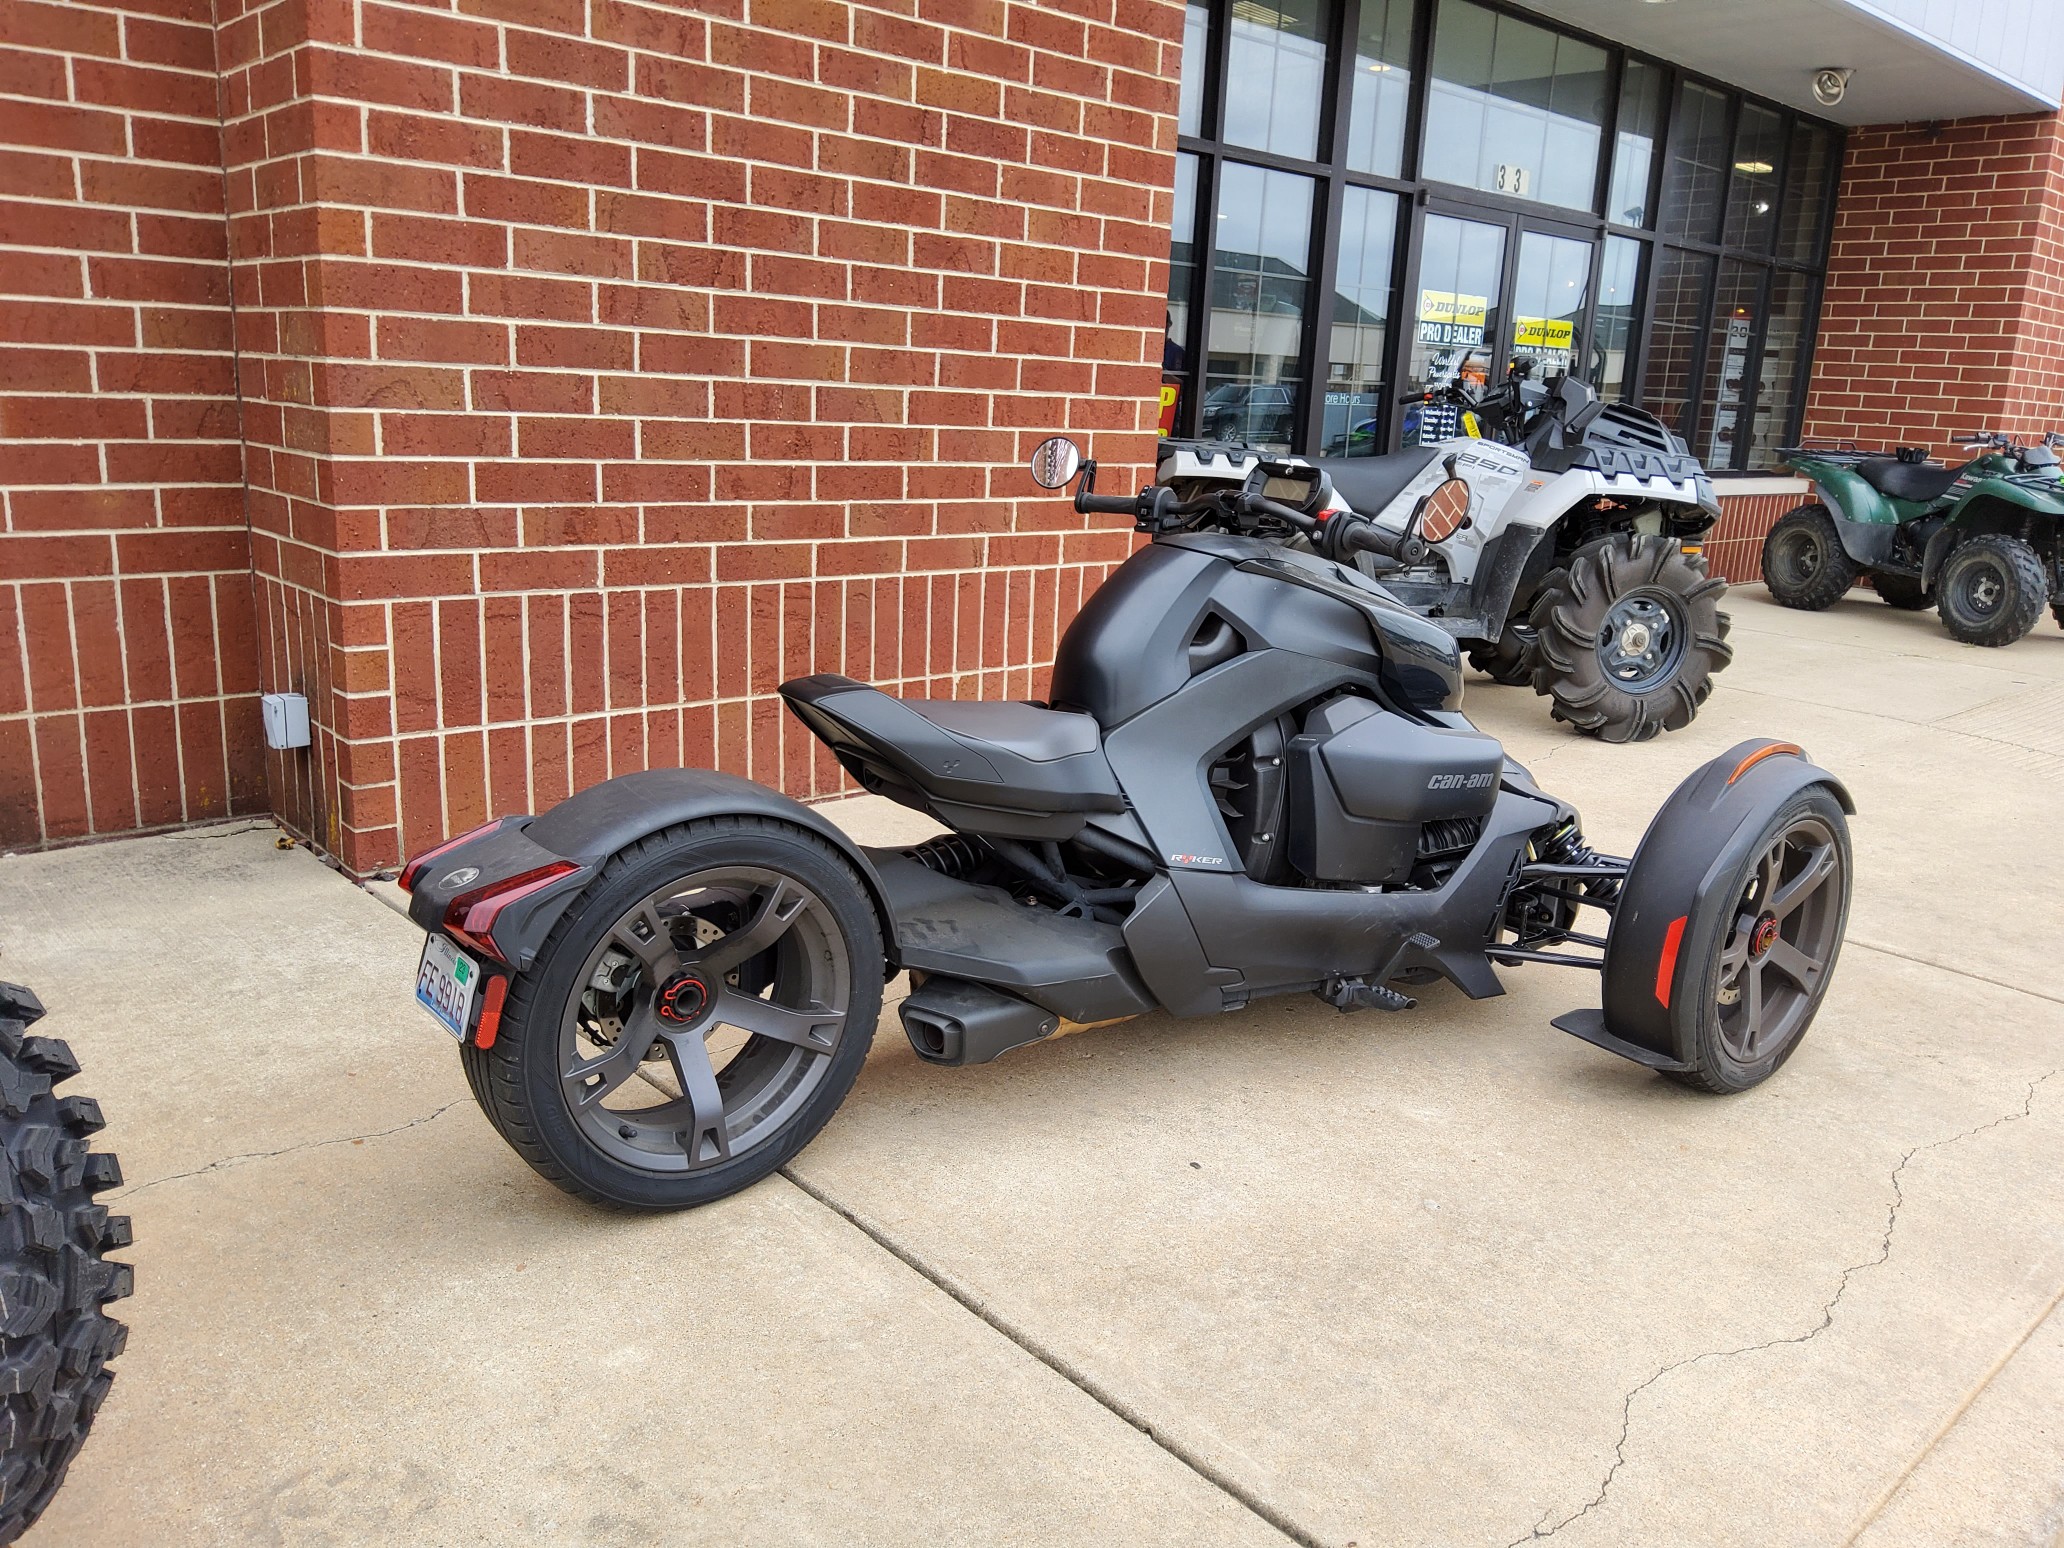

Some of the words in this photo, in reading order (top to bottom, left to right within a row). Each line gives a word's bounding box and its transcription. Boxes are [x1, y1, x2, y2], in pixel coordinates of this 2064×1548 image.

[1435, 301, 1484, 316] DUNLOP
[1420, 322, 1441, 342] PRO
[1443, 324, 1482, 345] DEALER
[1528, 326, 1571, 339] DUNLOP
[1477, 441, 1529, 463] SPORTSMAN
[1457, 452, 1519, 475] 850
[1427, 772, 1494, 790] can-am
[1171, 853, 1223, 865] RYKER
